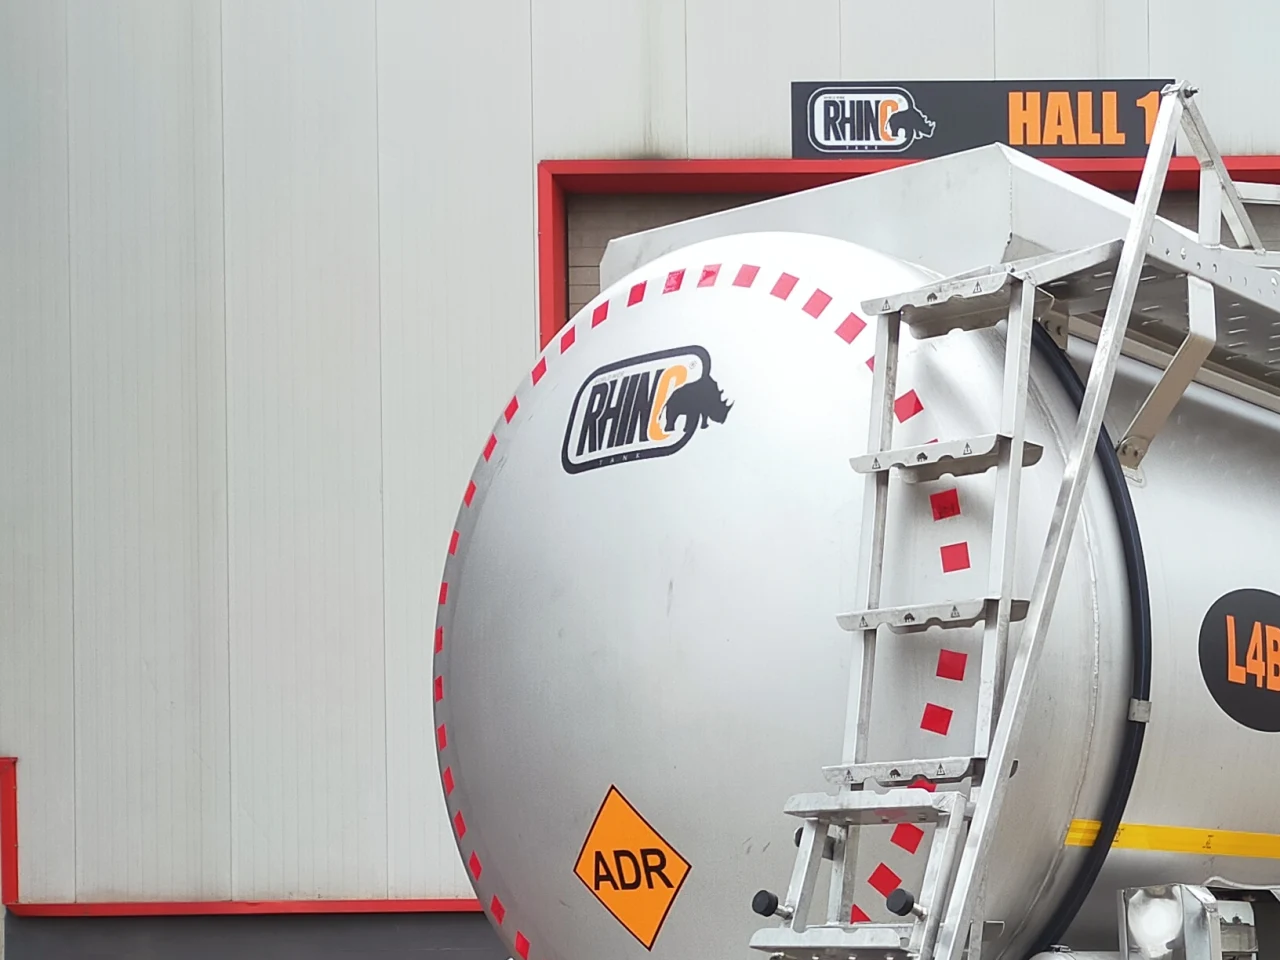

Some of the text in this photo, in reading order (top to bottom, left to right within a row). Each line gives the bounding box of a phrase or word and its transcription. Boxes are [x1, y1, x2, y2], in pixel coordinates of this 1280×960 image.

[1008, 91, 1161, 145] HALL 1
[594, 848, 675, 891] ADR
